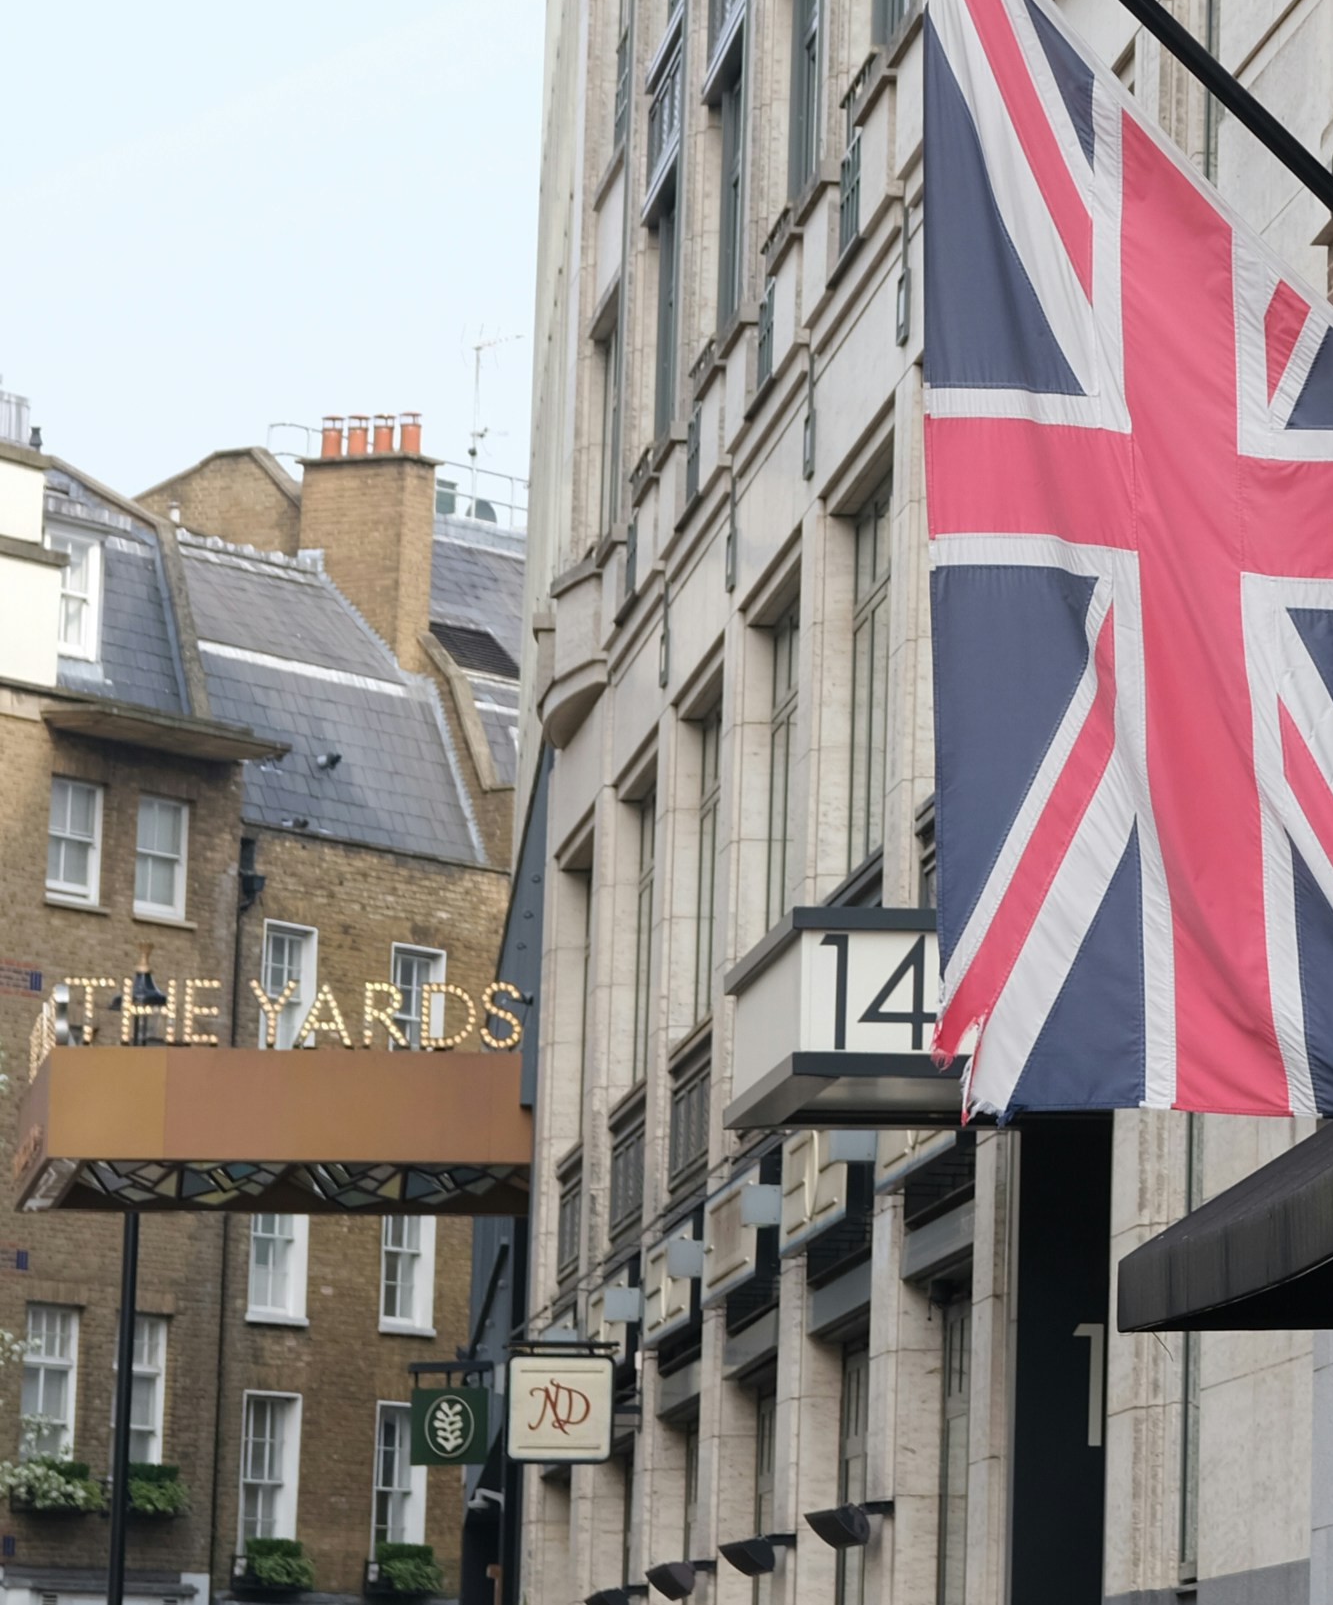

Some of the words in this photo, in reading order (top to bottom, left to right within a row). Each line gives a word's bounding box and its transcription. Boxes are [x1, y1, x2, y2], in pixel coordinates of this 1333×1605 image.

[63, 976, 221, 1046] THE
[248, 980, 523, 1050] YARDS
[819, 932, 937, 1051] 14
